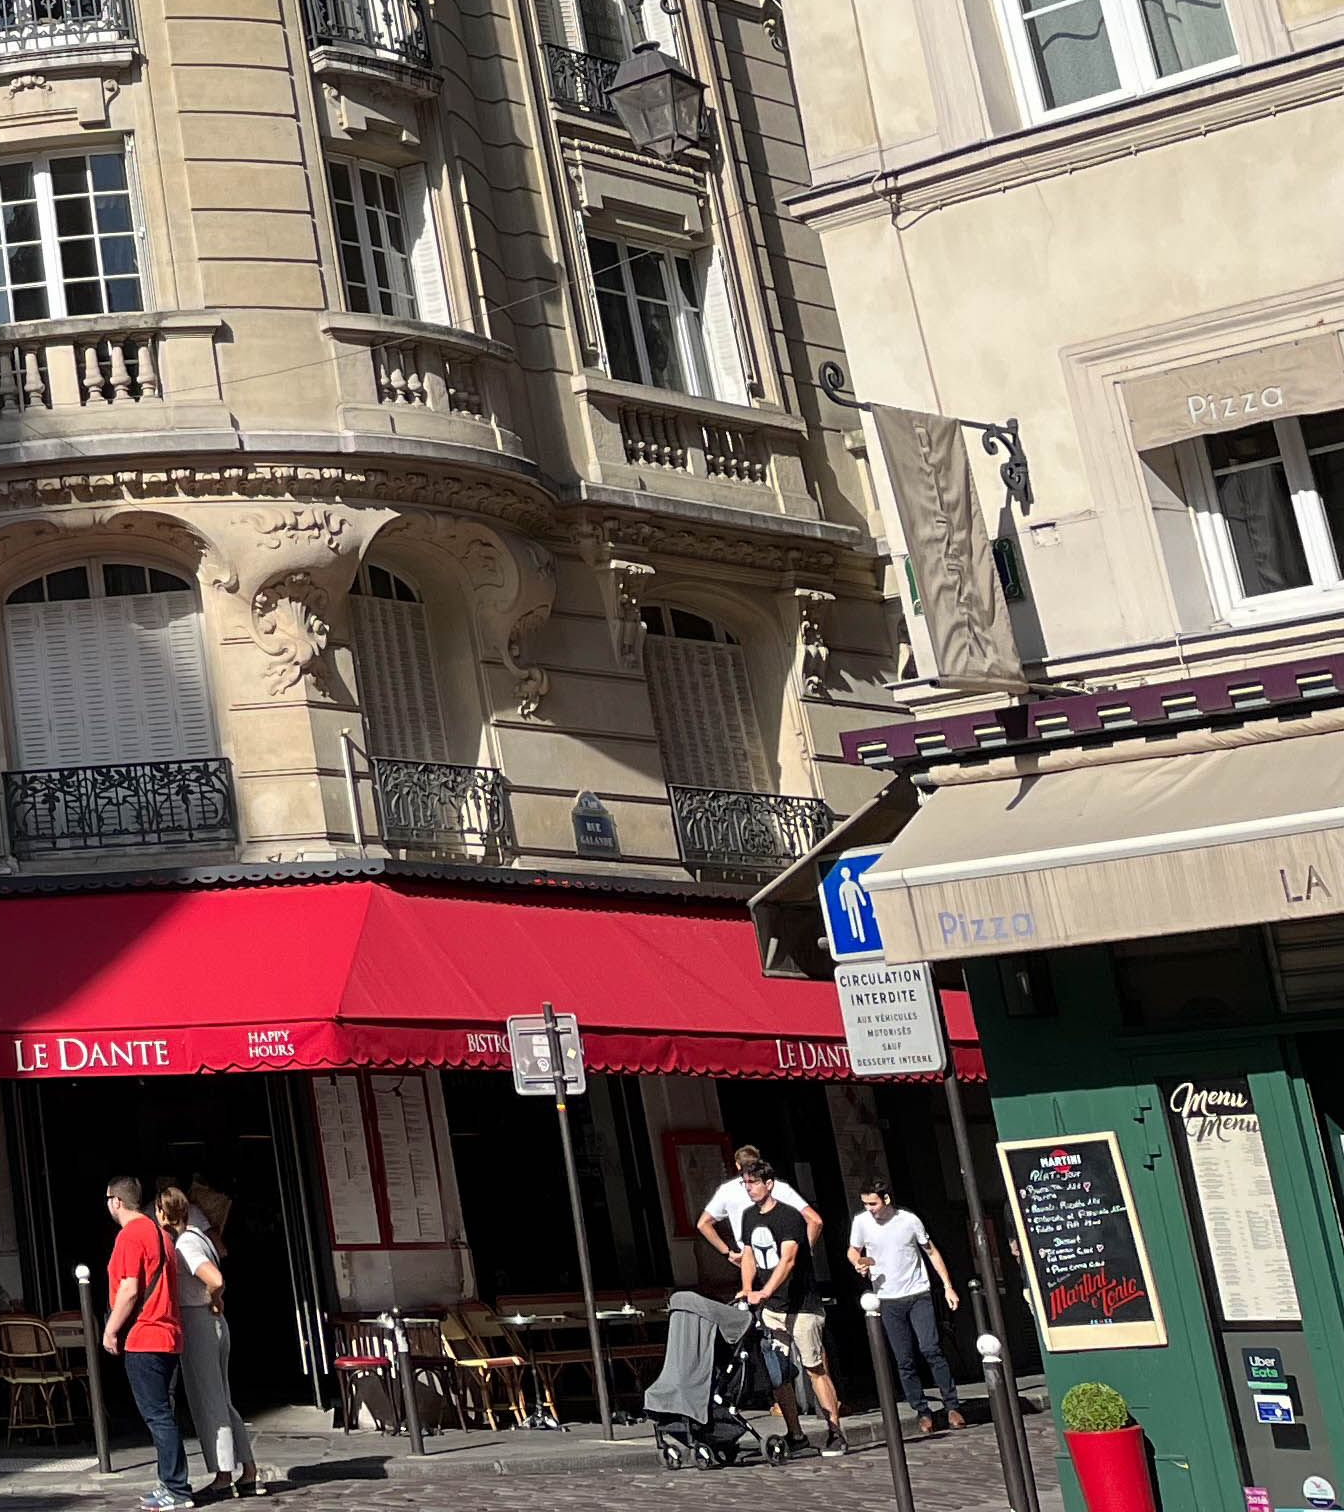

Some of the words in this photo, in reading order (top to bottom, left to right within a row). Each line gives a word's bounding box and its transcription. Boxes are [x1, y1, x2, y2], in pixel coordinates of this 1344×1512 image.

[1187, 386, 1283, 424] Pizza
[1279, 864, 1332, 904] LA
[938, 911, 1034, 945] Pizza
[839, 969, 922, 988] CIRCULATION
[851, 990, 917, 1006] INTERDITE
[857, 1015, 873, 1024] AUX
[875, 1012, 918, 1023] VÉHICULES
[247, 1029, 291, 1045] HAPPY
[248, 1043, 295, 1059] HOURS
[882, 1042, 902, 1051] SAUF
[857, 1057, 896, 1067] DESSERTE
[899, 1054, 933, 1064] INTERNE
[1170, 1082, 1248, 1117] Menu
[1040, 1154, 1082, 1169] MARTINI
[1049, 1266, 1107, 1321] Martini
[1096, 1276, 1145, 1317] Tonic
[1248, 1355, 1276, 1367] Uber
[1252, 1368, 1279, 1378] Eats
